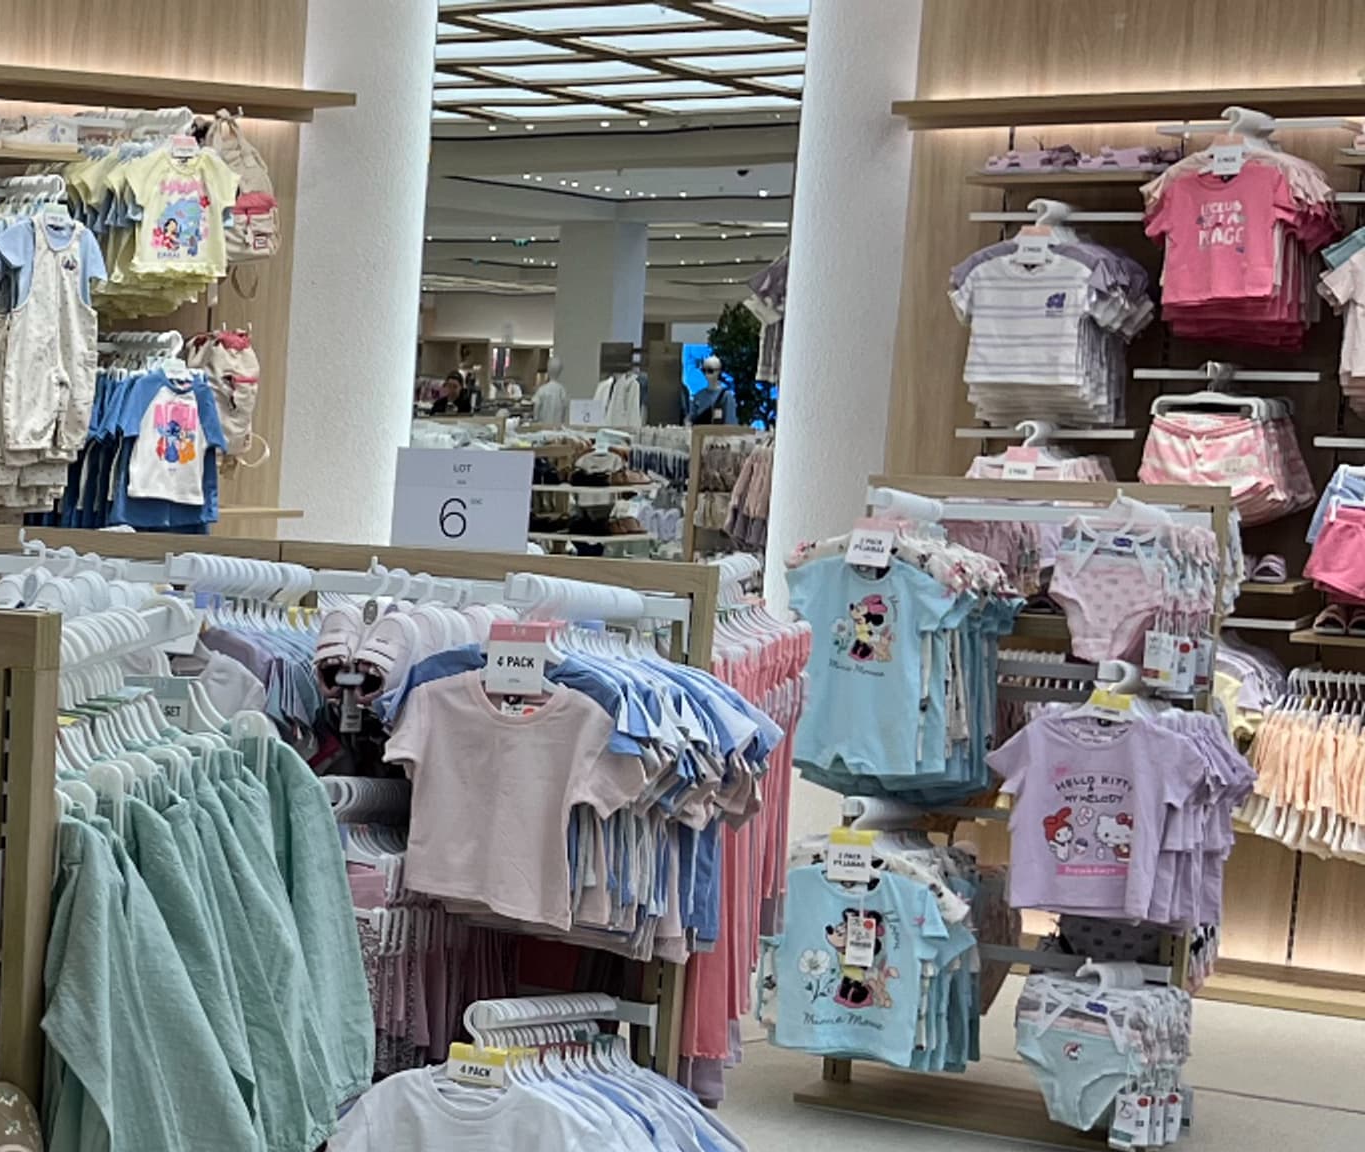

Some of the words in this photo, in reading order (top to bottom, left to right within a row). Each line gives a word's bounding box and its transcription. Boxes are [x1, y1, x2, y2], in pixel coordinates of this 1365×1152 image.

[453, 464, 472, 473] LOT
[439, 497, 467, 539] 6
[497, 655, 504, 668] 4
[507, 655, 535, 669] PACK
[1055, 776, 1096, 791] HELLO
[1101, 776, 1133, 792] KITTY
[459, 1063, 467, 1074] 4
[468, 1065, 493, 1078] PACK
